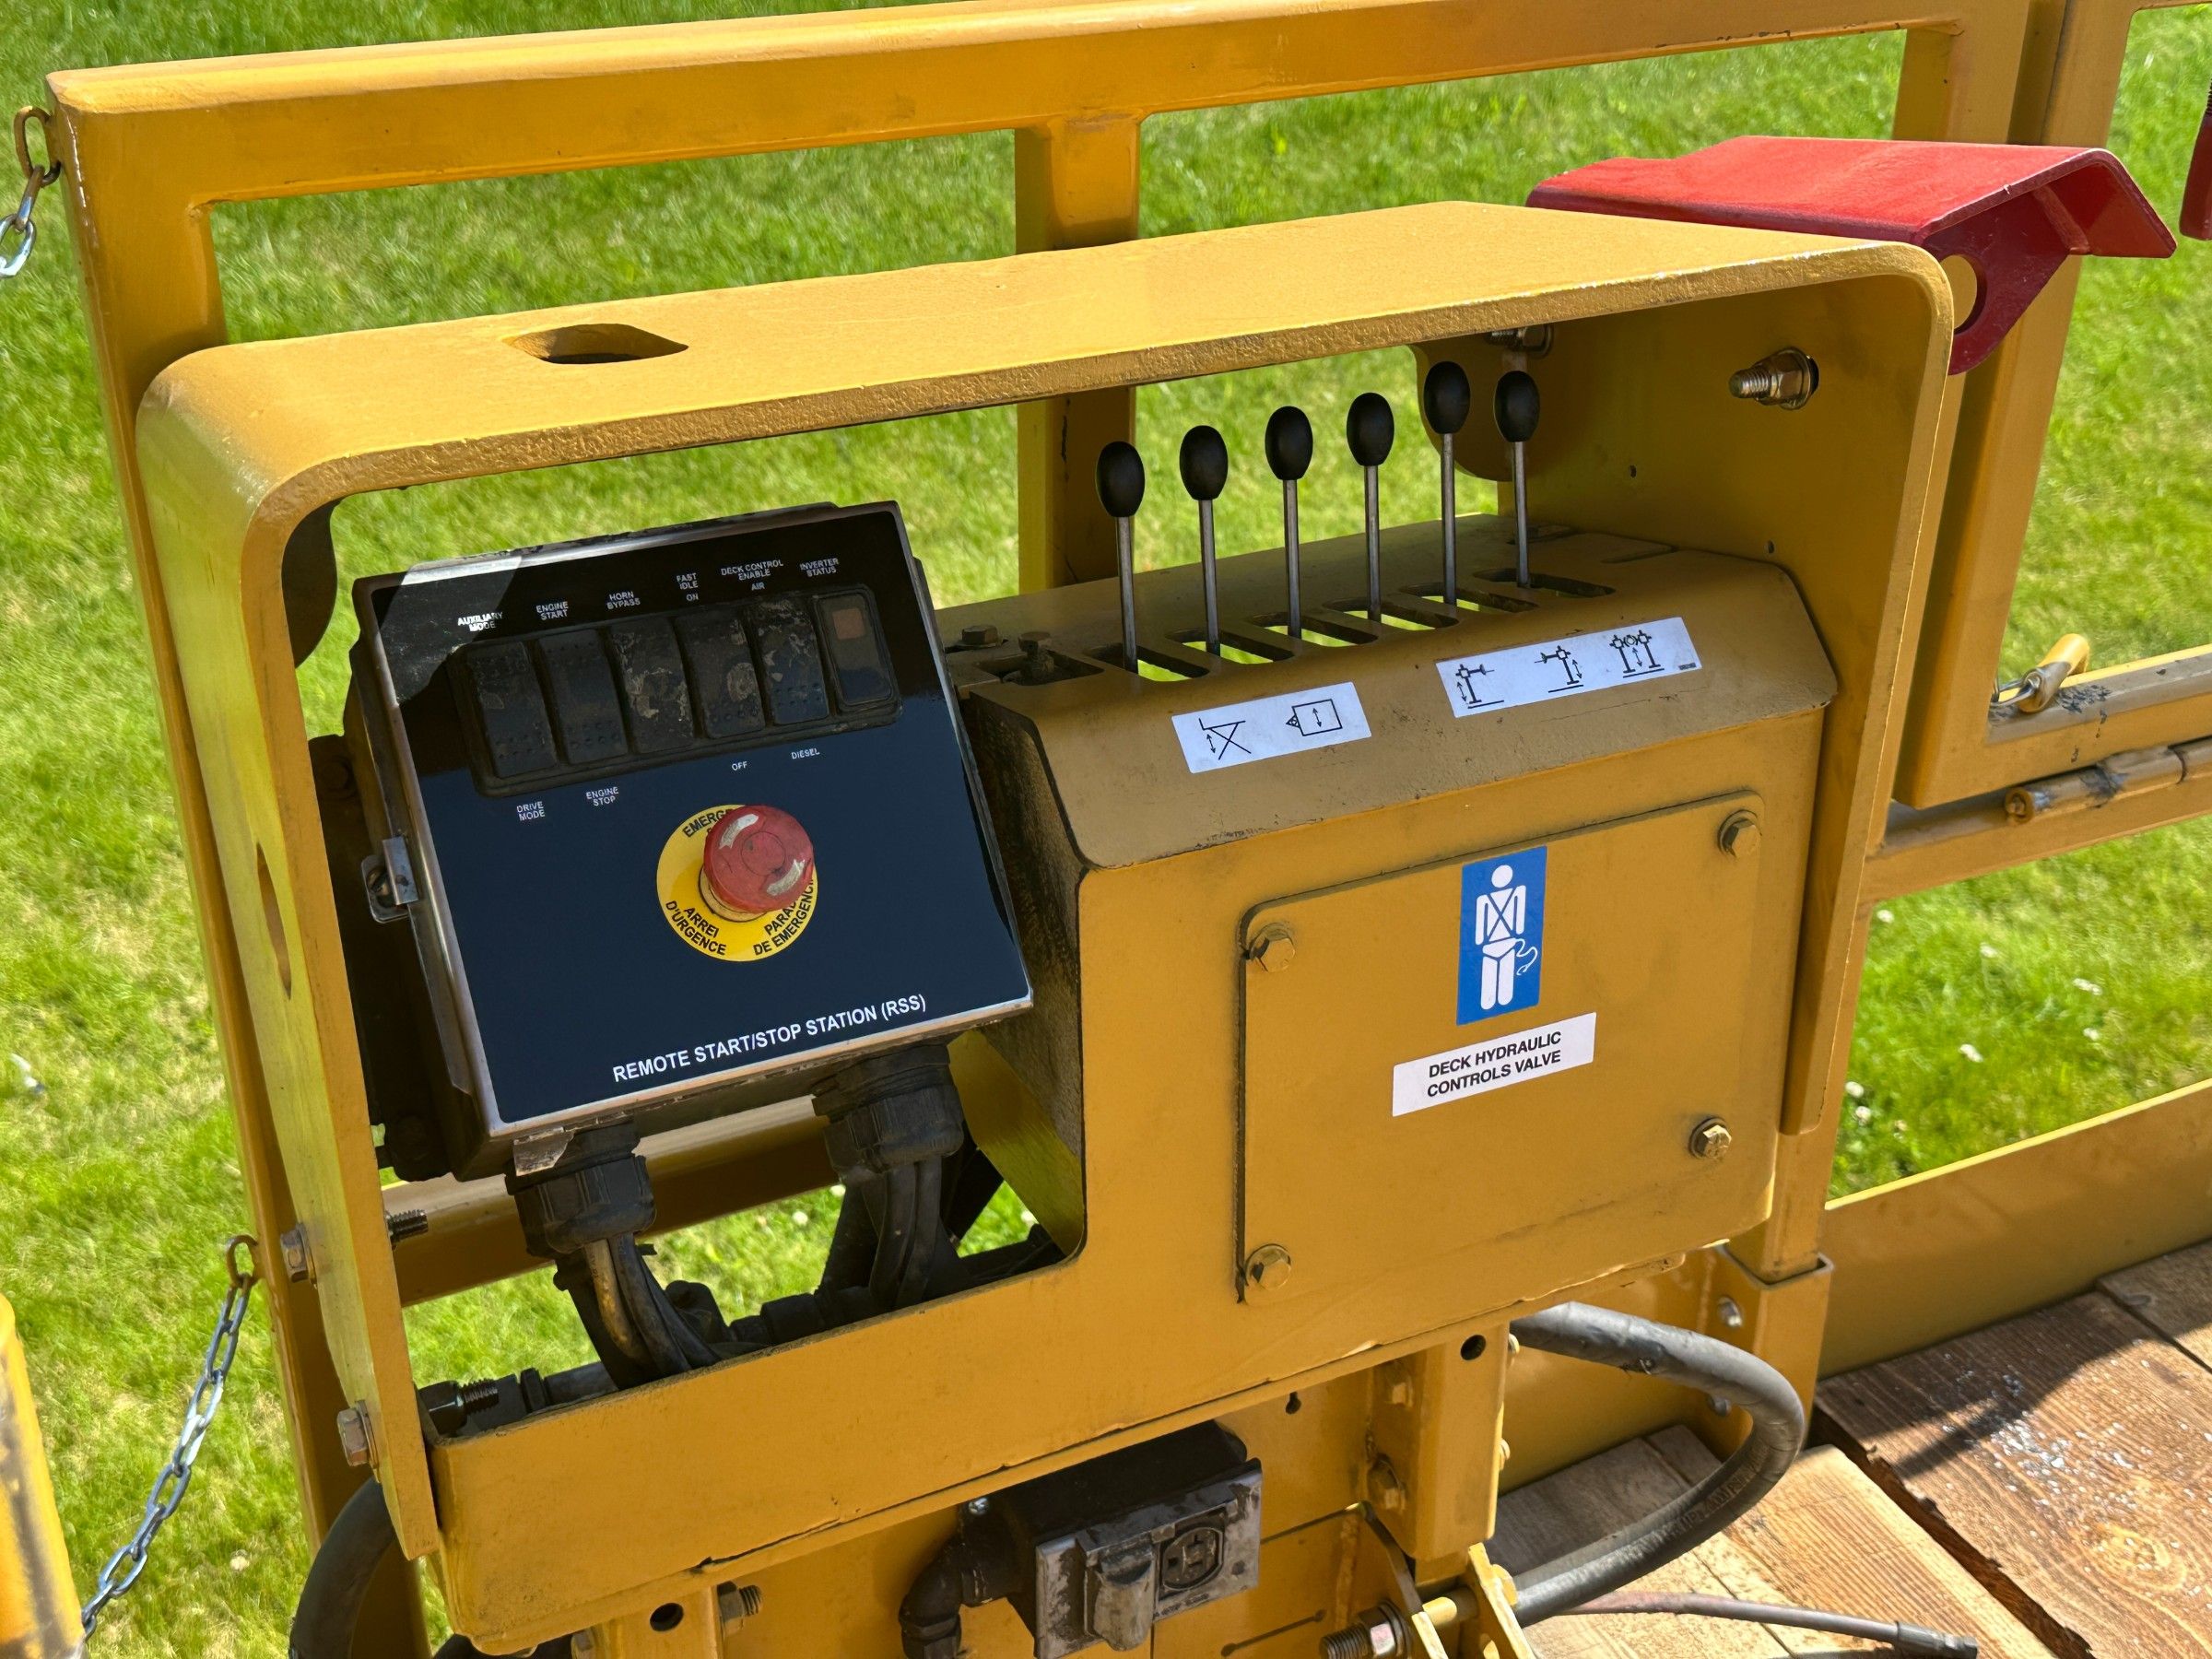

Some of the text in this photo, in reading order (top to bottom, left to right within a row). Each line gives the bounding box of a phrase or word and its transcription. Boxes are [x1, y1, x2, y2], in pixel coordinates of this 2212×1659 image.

[721, 559, 783, 576] DECK CONTROL
[800, 558, 839, 571] INVERTER
[677, 572, 698, 582] FAST
[738, 569, 771, 581] ENABLE
[806, 566, 837, 577] STATUS
[679, 581, 699, 590] IDLE
[751, 582, 765, 591] AIR
[609, 591, 634, 601] HORN
[535, 601, 569, 613] ENGINE
[606, 597, 641, 609] BYPASS
[457, 612, 503, 627] AUXILIARY
[540, 608, 568, 620] START
[469, 620, 496, 632] MODE
[791, 747, 820, 759] DIESEL
[731, 761, 747, 771] OFF
[585, 786, 619, 800] ENGINE
[593, 794, 617, 807] STOP
[516, 801, 544, 814] DRIVE
[519, 808, 546, 821] MODE
[683, 809, 727, 837] EMERG
[665, 900, 727, 956] D'URGENCE
[753, 940, 772, 956] DE
[612, 994, 926, 1082] REMOTE START/STOP STATION (RSS)
[1429, 1030, 1561, 1078] DECK HYDRAULIC
[1427, 1050, 1561, 1097] CONTROLS VALVE
